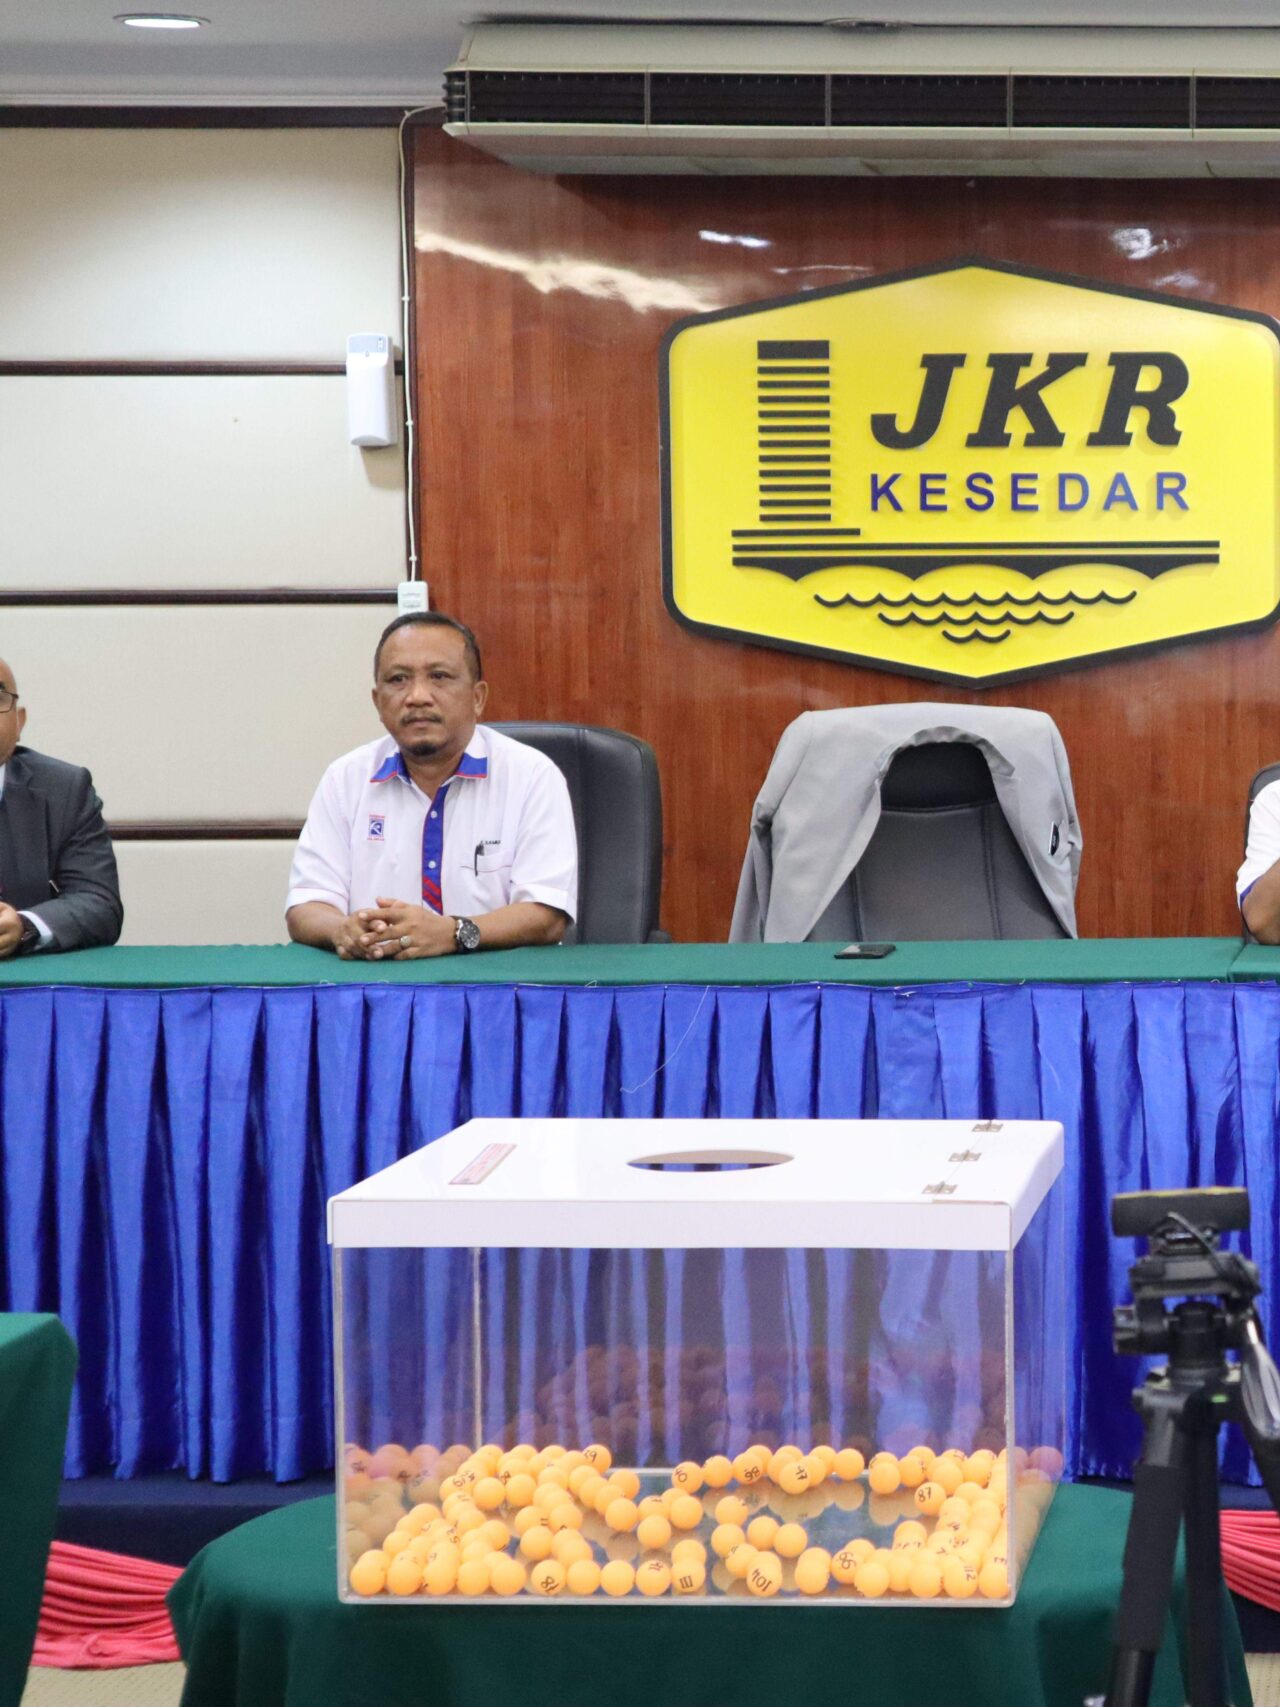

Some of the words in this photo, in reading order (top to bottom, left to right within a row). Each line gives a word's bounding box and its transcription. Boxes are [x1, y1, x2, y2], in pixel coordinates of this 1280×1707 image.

[871, 351, 1190, 450] JKR
[870, 471, 1190, 512] KESEDAR
[917, 1486, 932, 1502] 87
